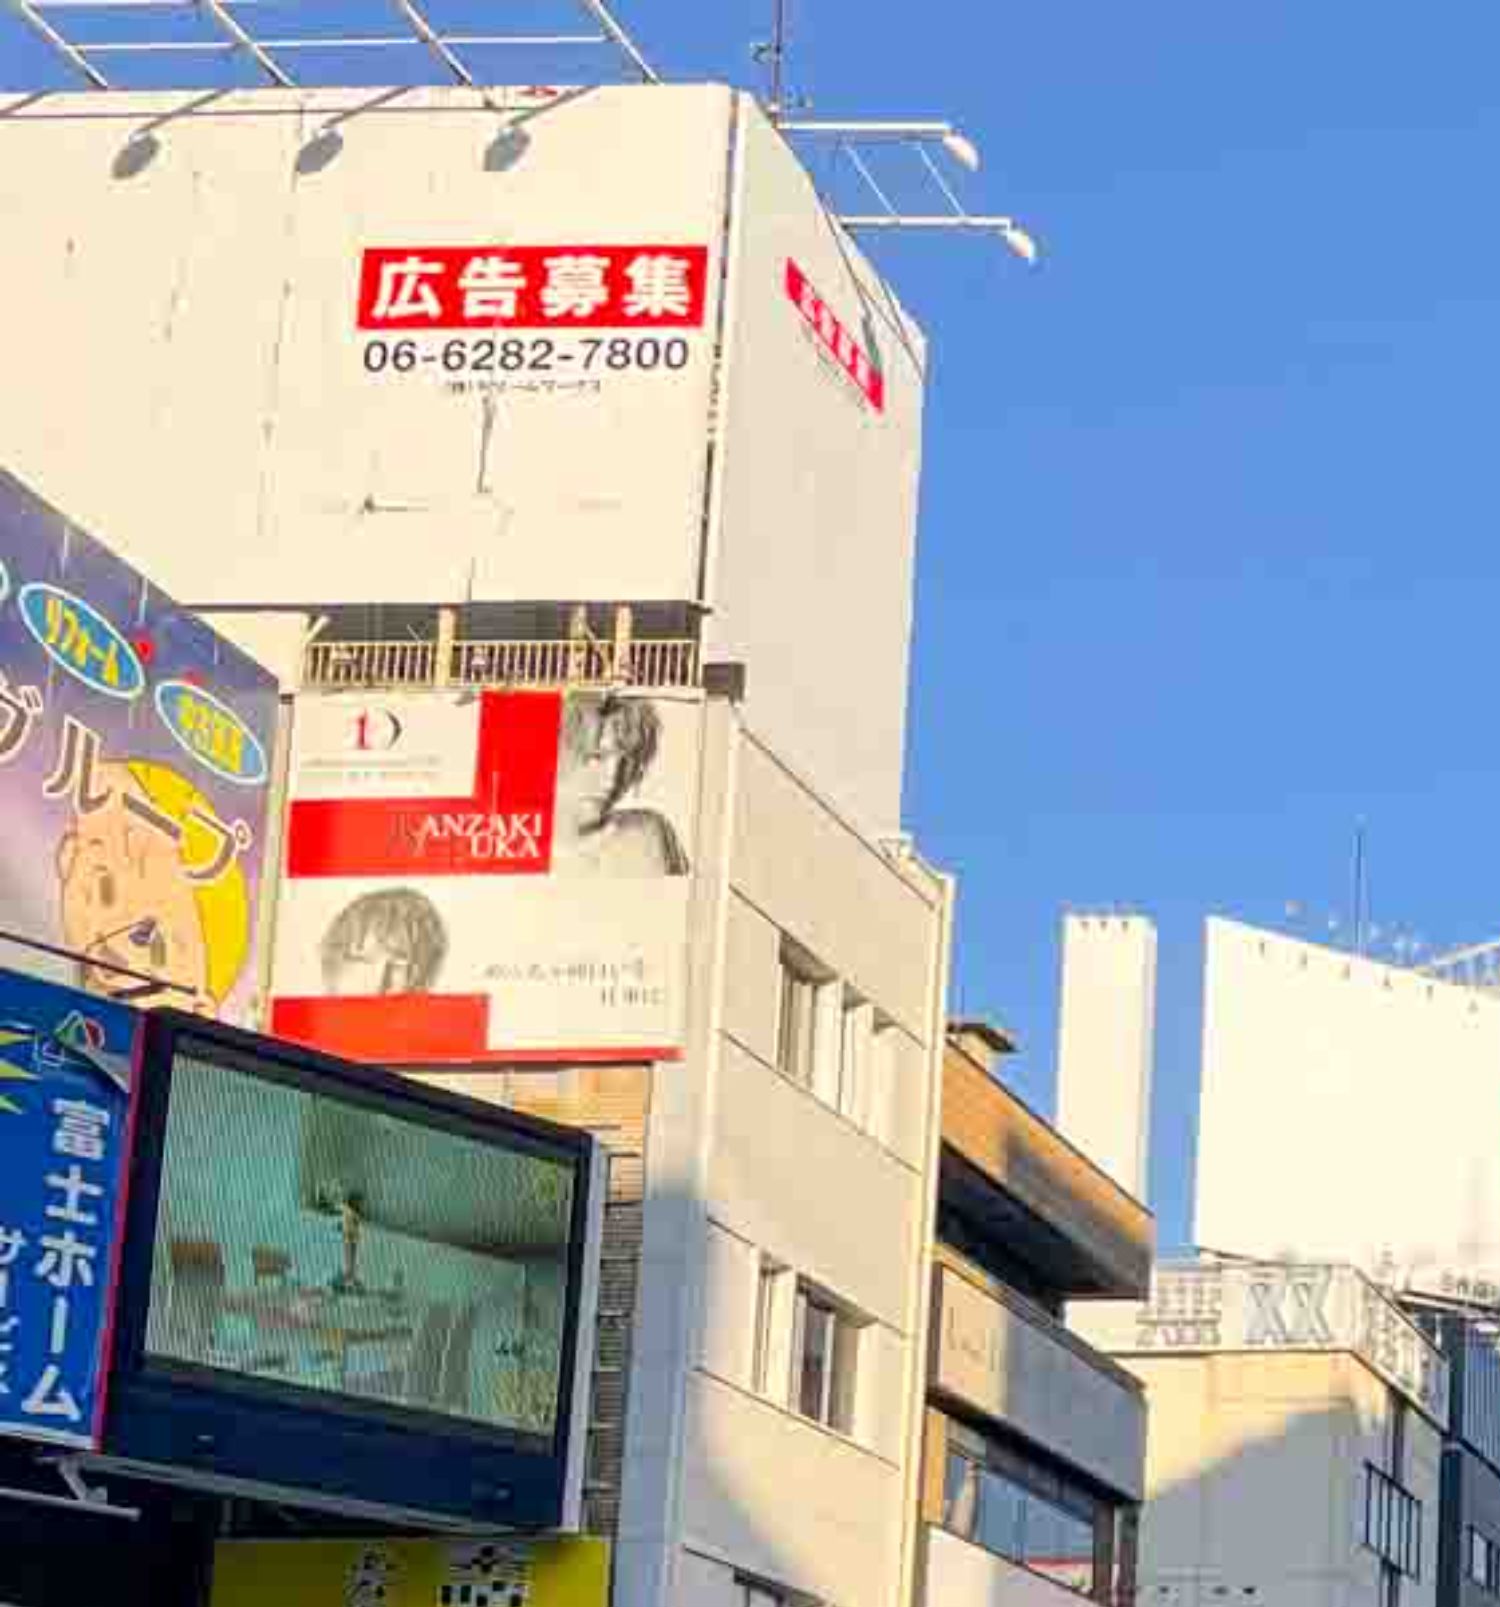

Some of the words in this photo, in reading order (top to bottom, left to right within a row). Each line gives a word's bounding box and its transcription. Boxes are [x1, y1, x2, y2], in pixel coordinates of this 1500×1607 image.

[371, 254, 691, 318] 広告募集
[364, 338, 689, 372] 06-6282-7800
[45, 598, 120, 688] リフォーム
[22, 1098, 110, 1421] 富士ホーム
